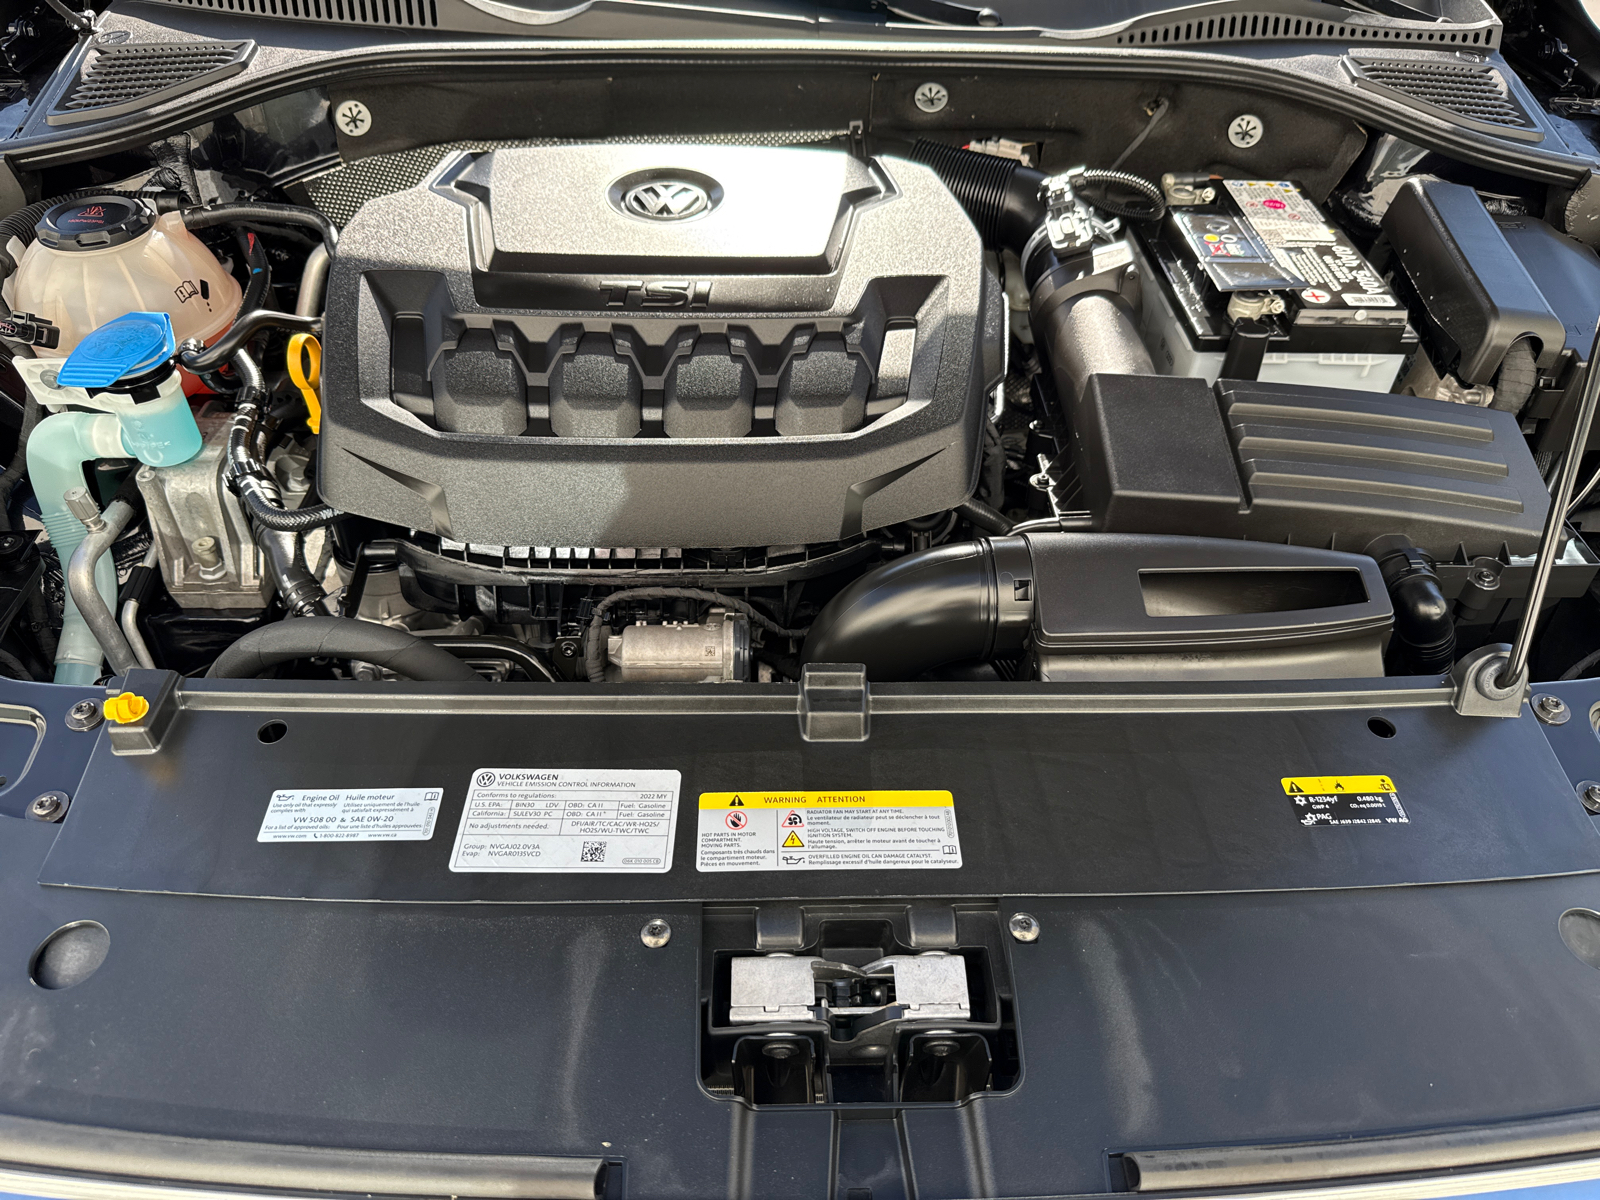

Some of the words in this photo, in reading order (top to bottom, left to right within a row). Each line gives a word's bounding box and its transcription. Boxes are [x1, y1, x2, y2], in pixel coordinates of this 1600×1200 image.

[1332, 246, 1361, 267] 61Ah
[599, 280, 712, 307] TSI
[499, 773, 559, 781] VOLKSWAGEN
[302, 794, 327, 802] Engine
[763, 796, 807, 804] WARNING
[817, 795, 866, 803] ATTENTION
[1308, 796, 1338, 804] R-1234yf
[1374, 795, 1384, 803] kg
[463, 843, 487, 851] Group:
